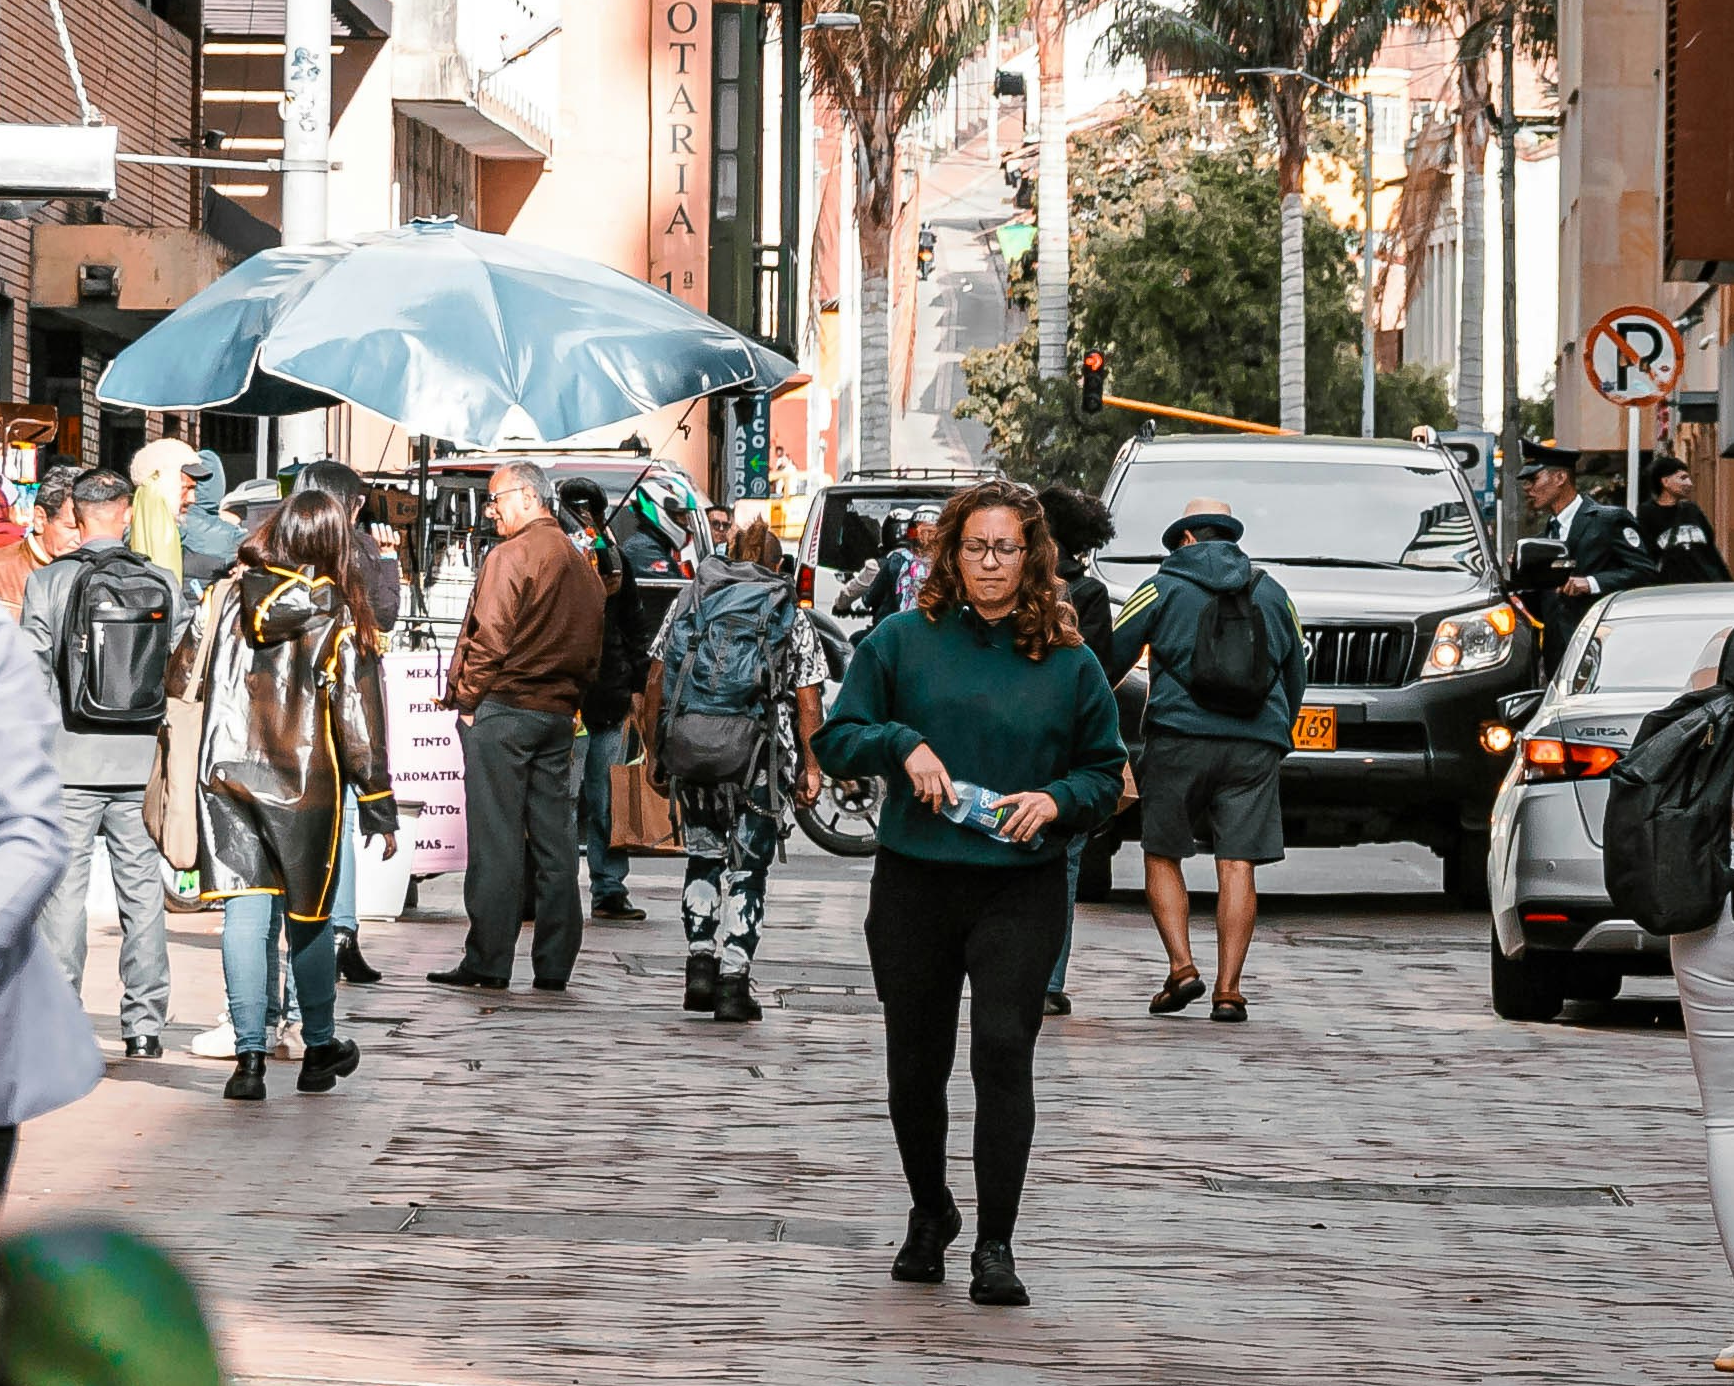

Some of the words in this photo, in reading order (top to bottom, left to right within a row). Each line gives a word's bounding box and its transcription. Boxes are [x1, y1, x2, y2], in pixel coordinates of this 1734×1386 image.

[1574, 727, 1629, 737] VERSA
[412, 736, 451, 747] TINTO
[414, 839, 442, 850] MAS
